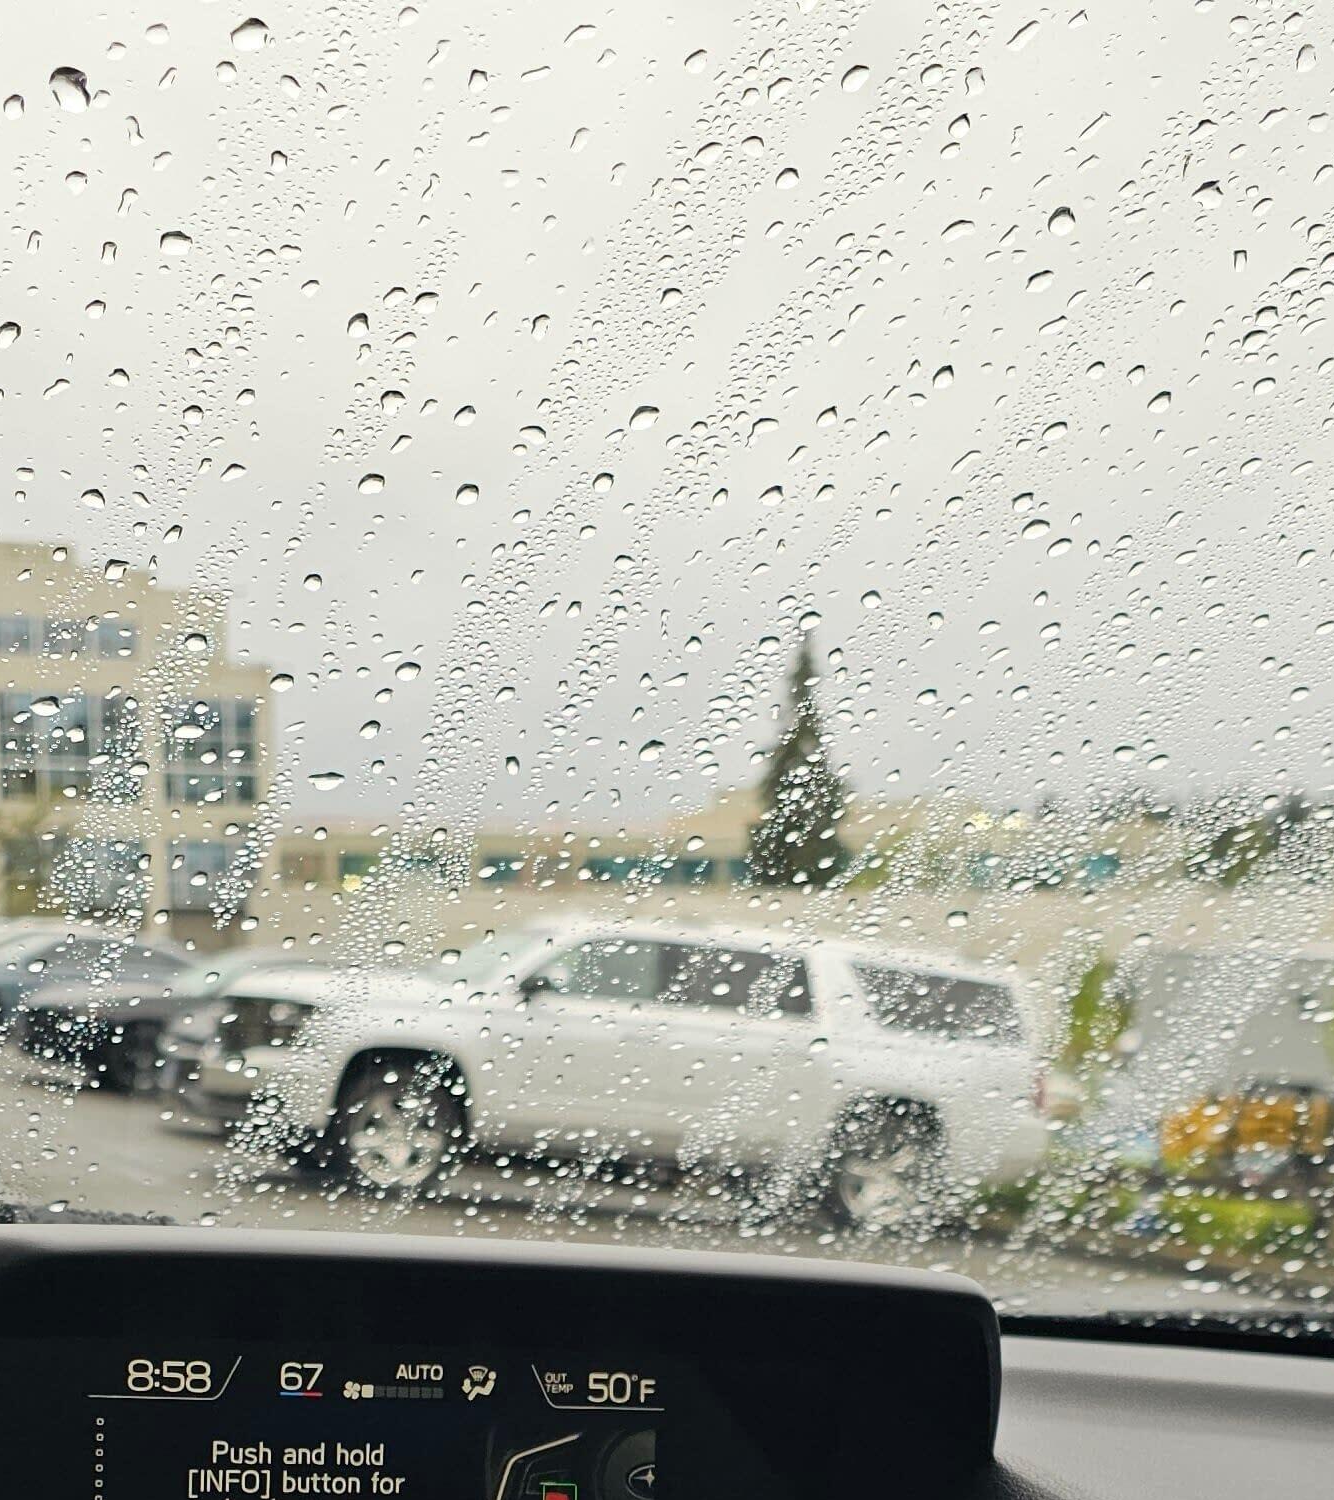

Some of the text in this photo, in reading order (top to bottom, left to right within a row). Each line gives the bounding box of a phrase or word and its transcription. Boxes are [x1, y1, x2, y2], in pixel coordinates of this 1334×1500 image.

[127, 1359, 212, 1394] 8:58
[280, 1361, 324, 1391] 67
[395, 1363, 444, 1381] AUTO
[544, 1371, 568, 1384] OUT
[545, 1383, 574, 1394] TEMP
[212, 1440, 385, 1467] Push and hold
[188, 1468, 406, 1500] [INFO] button for
